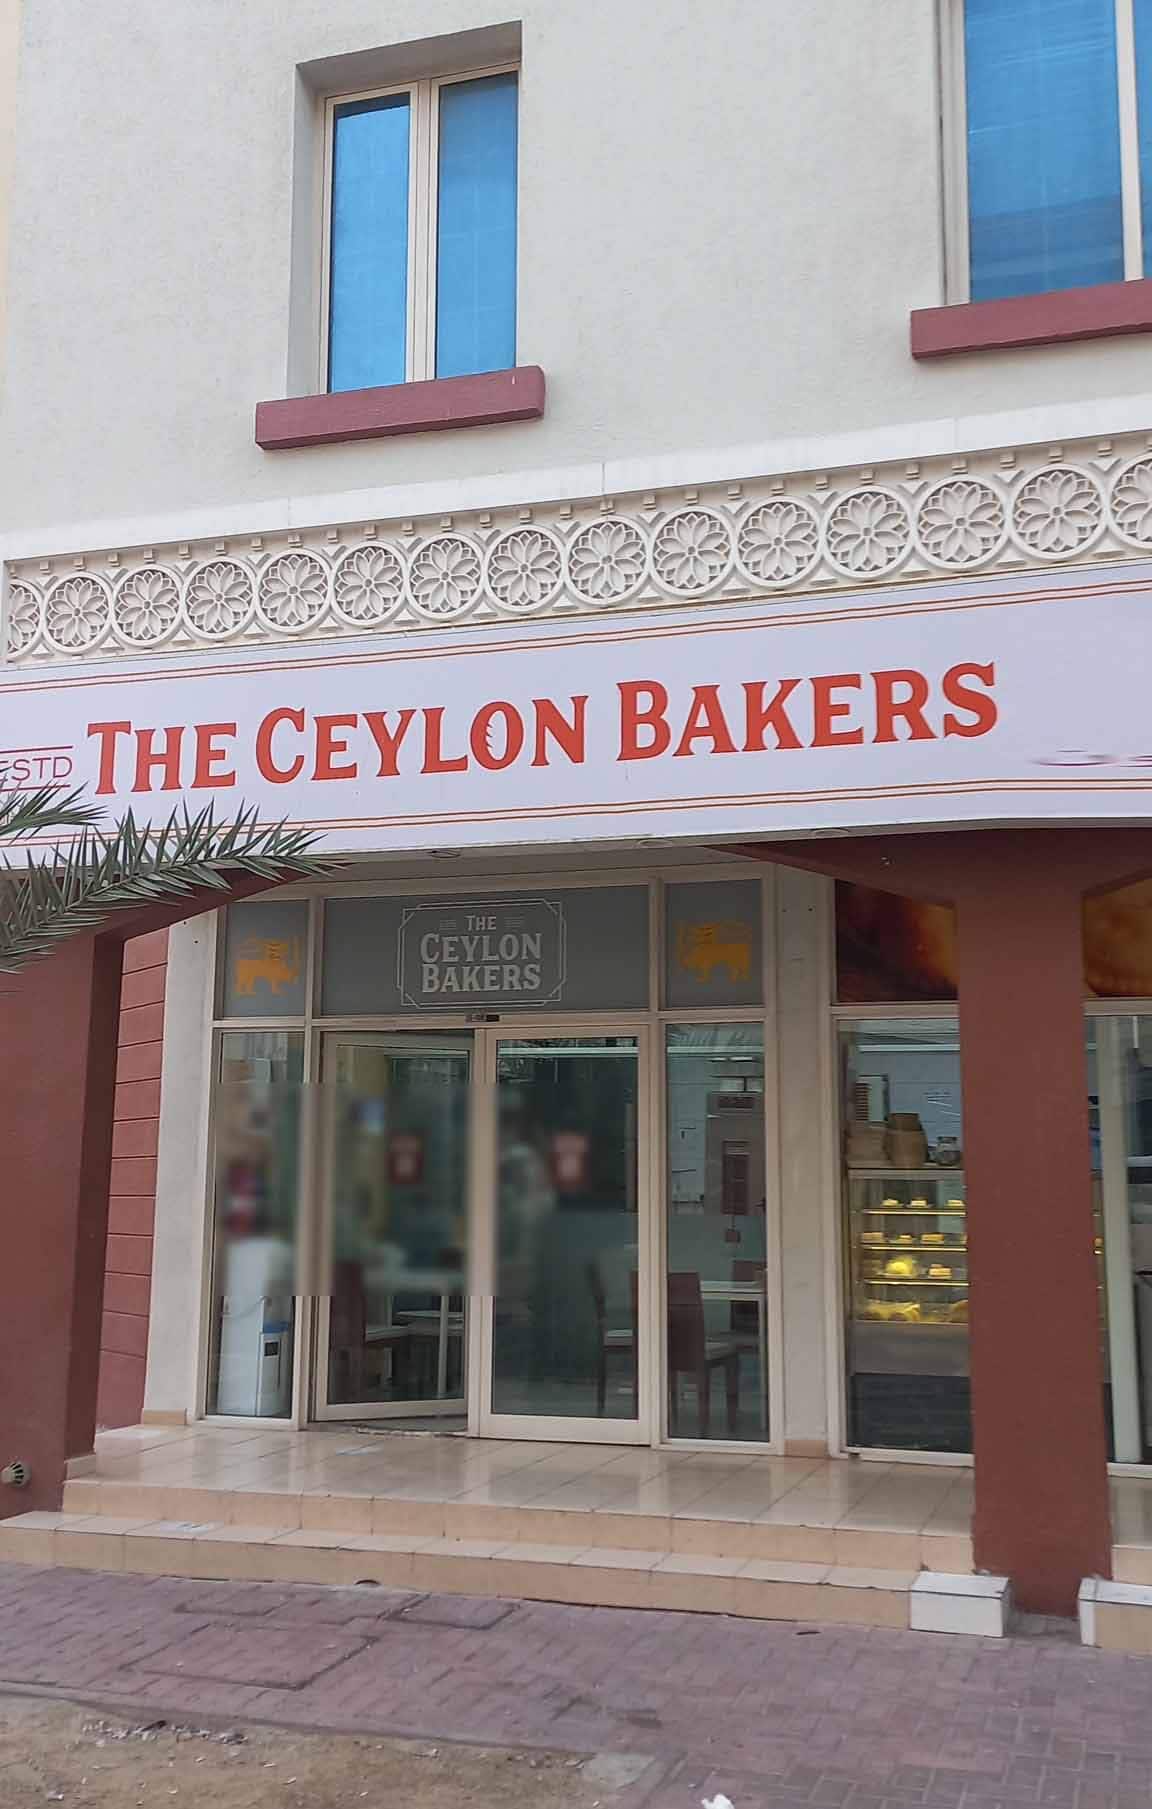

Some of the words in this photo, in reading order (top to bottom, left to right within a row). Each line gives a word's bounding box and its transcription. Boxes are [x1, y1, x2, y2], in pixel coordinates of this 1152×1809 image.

[87, 721, 238, 796] THE
[255, 695, 588, 785] CEYLON
[617, 662, 1000, 762] BAKERS
[465, 915, 497, 931] THE
[420, 932, 542, 964] CEYLON
[421, 963, 542, 993] BAKERS
